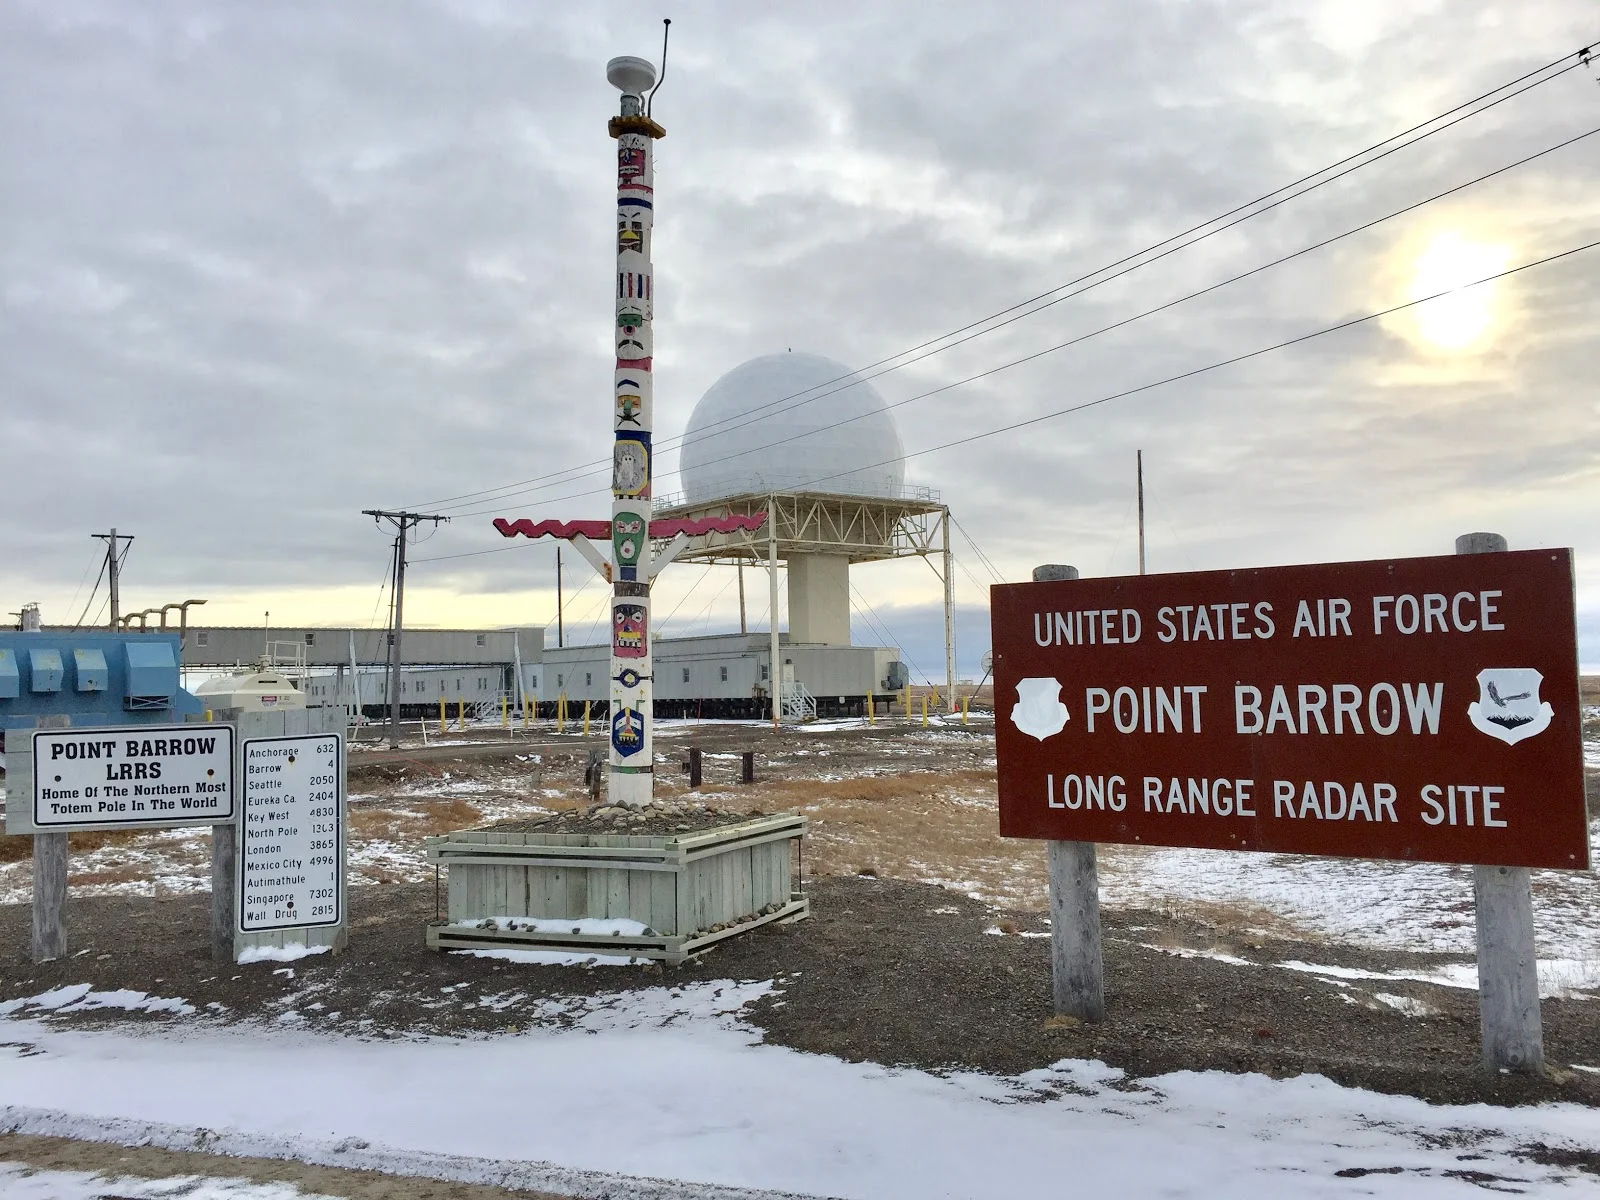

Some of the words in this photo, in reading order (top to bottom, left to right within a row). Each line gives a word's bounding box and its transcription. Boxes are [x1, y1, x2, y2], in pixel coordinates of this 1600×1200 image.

[1034, 609, 1141, 647] UNITED
[1157, 602, 1275, 643] STATES
[1293, 598, 1352, 638] AIR
[1373, 590, 1506, 635] FORCE
[1085, 685, 1208, 734] POINT
[1235, 682, 1444, 736] BARROW
[51, 741, 116, 760] POINT
[126, 737, 216, 757] BARROW
[249, 748, 299, 758] Anchorage
[316, 743, 334, 754] 632
[106, 762, 162, 781] LRRS
[249, 765, 282, 774] Barrow
[328, 759, 334, 768] 4
[42, 788, 79, 800] Home
[85, 786, 98, 798] Of
[103, 785, 128, 797] The
[134, 783, 190, 796] Northern
[195, 781, 227, 793] Most
[248, 780, 282, 790] Seattle
[310, 775, 334, 786] 2050
[51, 803, 93, 814] Totem
[98, 801, 126, 812] Pole
[131, 800, 145, 811] In
[150, 798, 175, 810] The
[180, 796, 218, 809] World
[248, 796, 280, 806] Eureka
[283, 794, 297, 804] Ca.
[309, 791, 334, 802] 2404
[1047, 774, 1126, 812] LONG
[1144, 777, 1257, 817] RANGE
[1273, 780, 1399, 824] RADAR
[1420, 785, 1508, 828] SITE
[248, 813, 265, 824] Key
[268, 811, 290, 821] West
[309, 807, 334, 817] 4830
[248, 828, 274, 839] North
[278, 827, 299, 836] Pole
[247, 844, 282, 855] London
[310, 839, 334, 850] 3865
[247, 861, 280, 871] Mexico
[283, 859, 302, 870] City
[309, 856, 334, 866] 4996
[247, 875, 306, 888] Autimathule
[247, 893, 294, 906] Singapore
[310, 888, 334, 899] 7302
[247, 911, 266, 921] Wall
[275, 909, 298, 920] Drug
[312, 904, 334, 916] 2815
